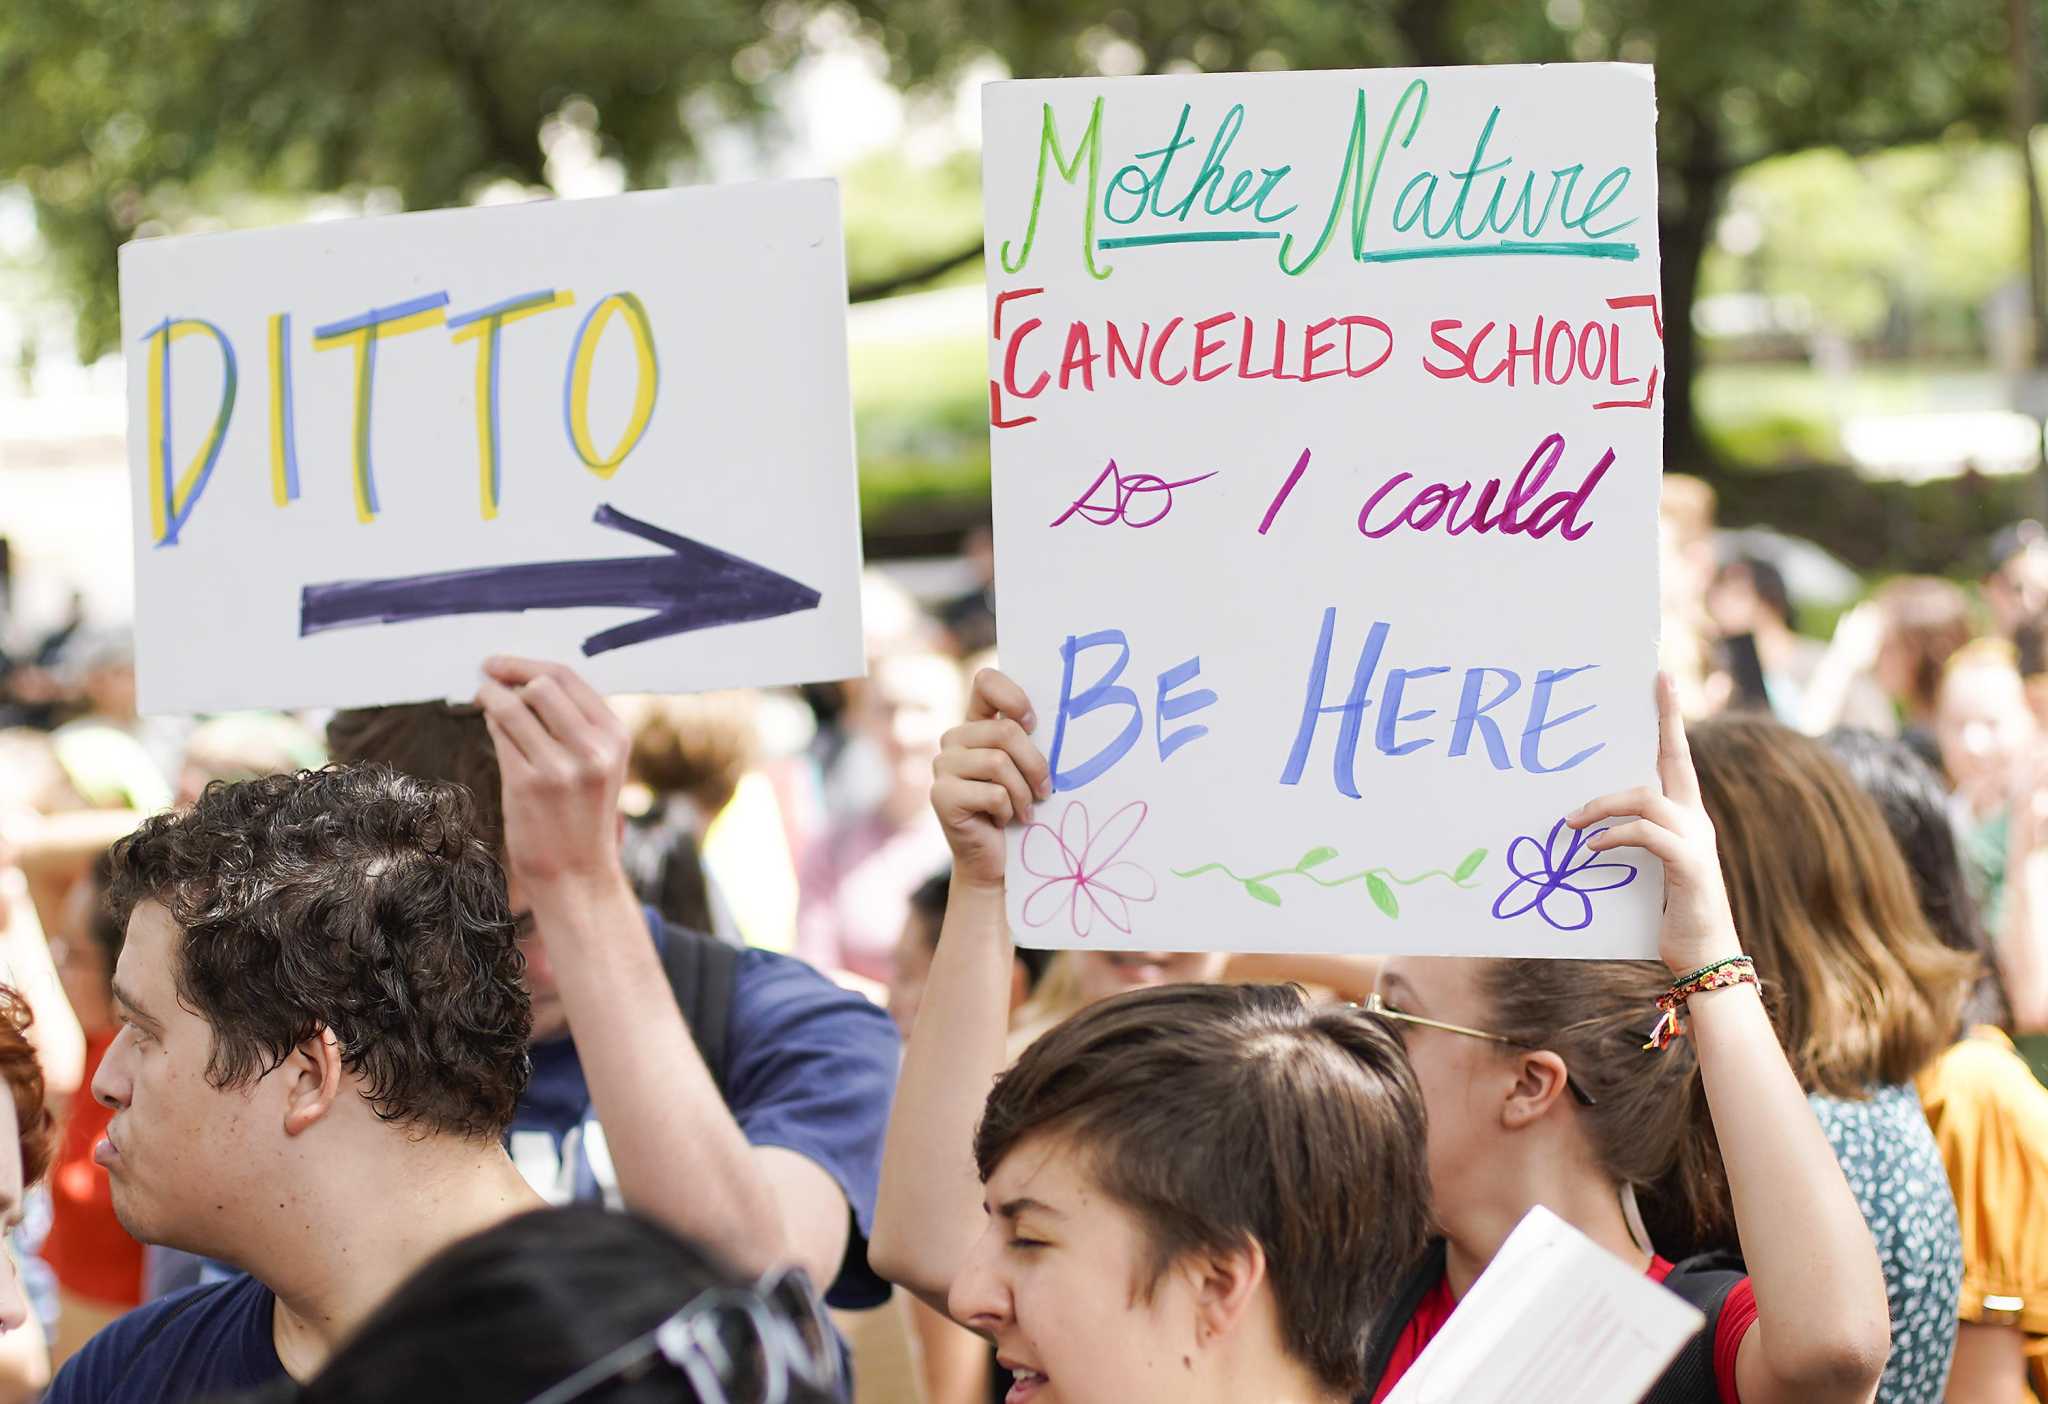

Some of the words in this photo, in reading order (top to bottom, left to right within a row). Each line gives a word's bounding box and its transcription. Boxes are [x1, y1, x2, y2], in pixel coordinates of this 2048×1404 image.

[1001, 95, 1297, 278] Mother
[1280, 79, 1639, 275] Nature
[141, 290, 661, 548] DITTO
[1004, 311, 1393, 398] CANCELLED
[1423, 314, 1639, 387] SCHOOL
[1051, 457, 1219, 528] so
[1258, 447, 1311, 536] I
[1357, 432, 1616, 540] could
[1051, 628, 1218, 794] BE
[1279, 606, 1606, 799] HERE
